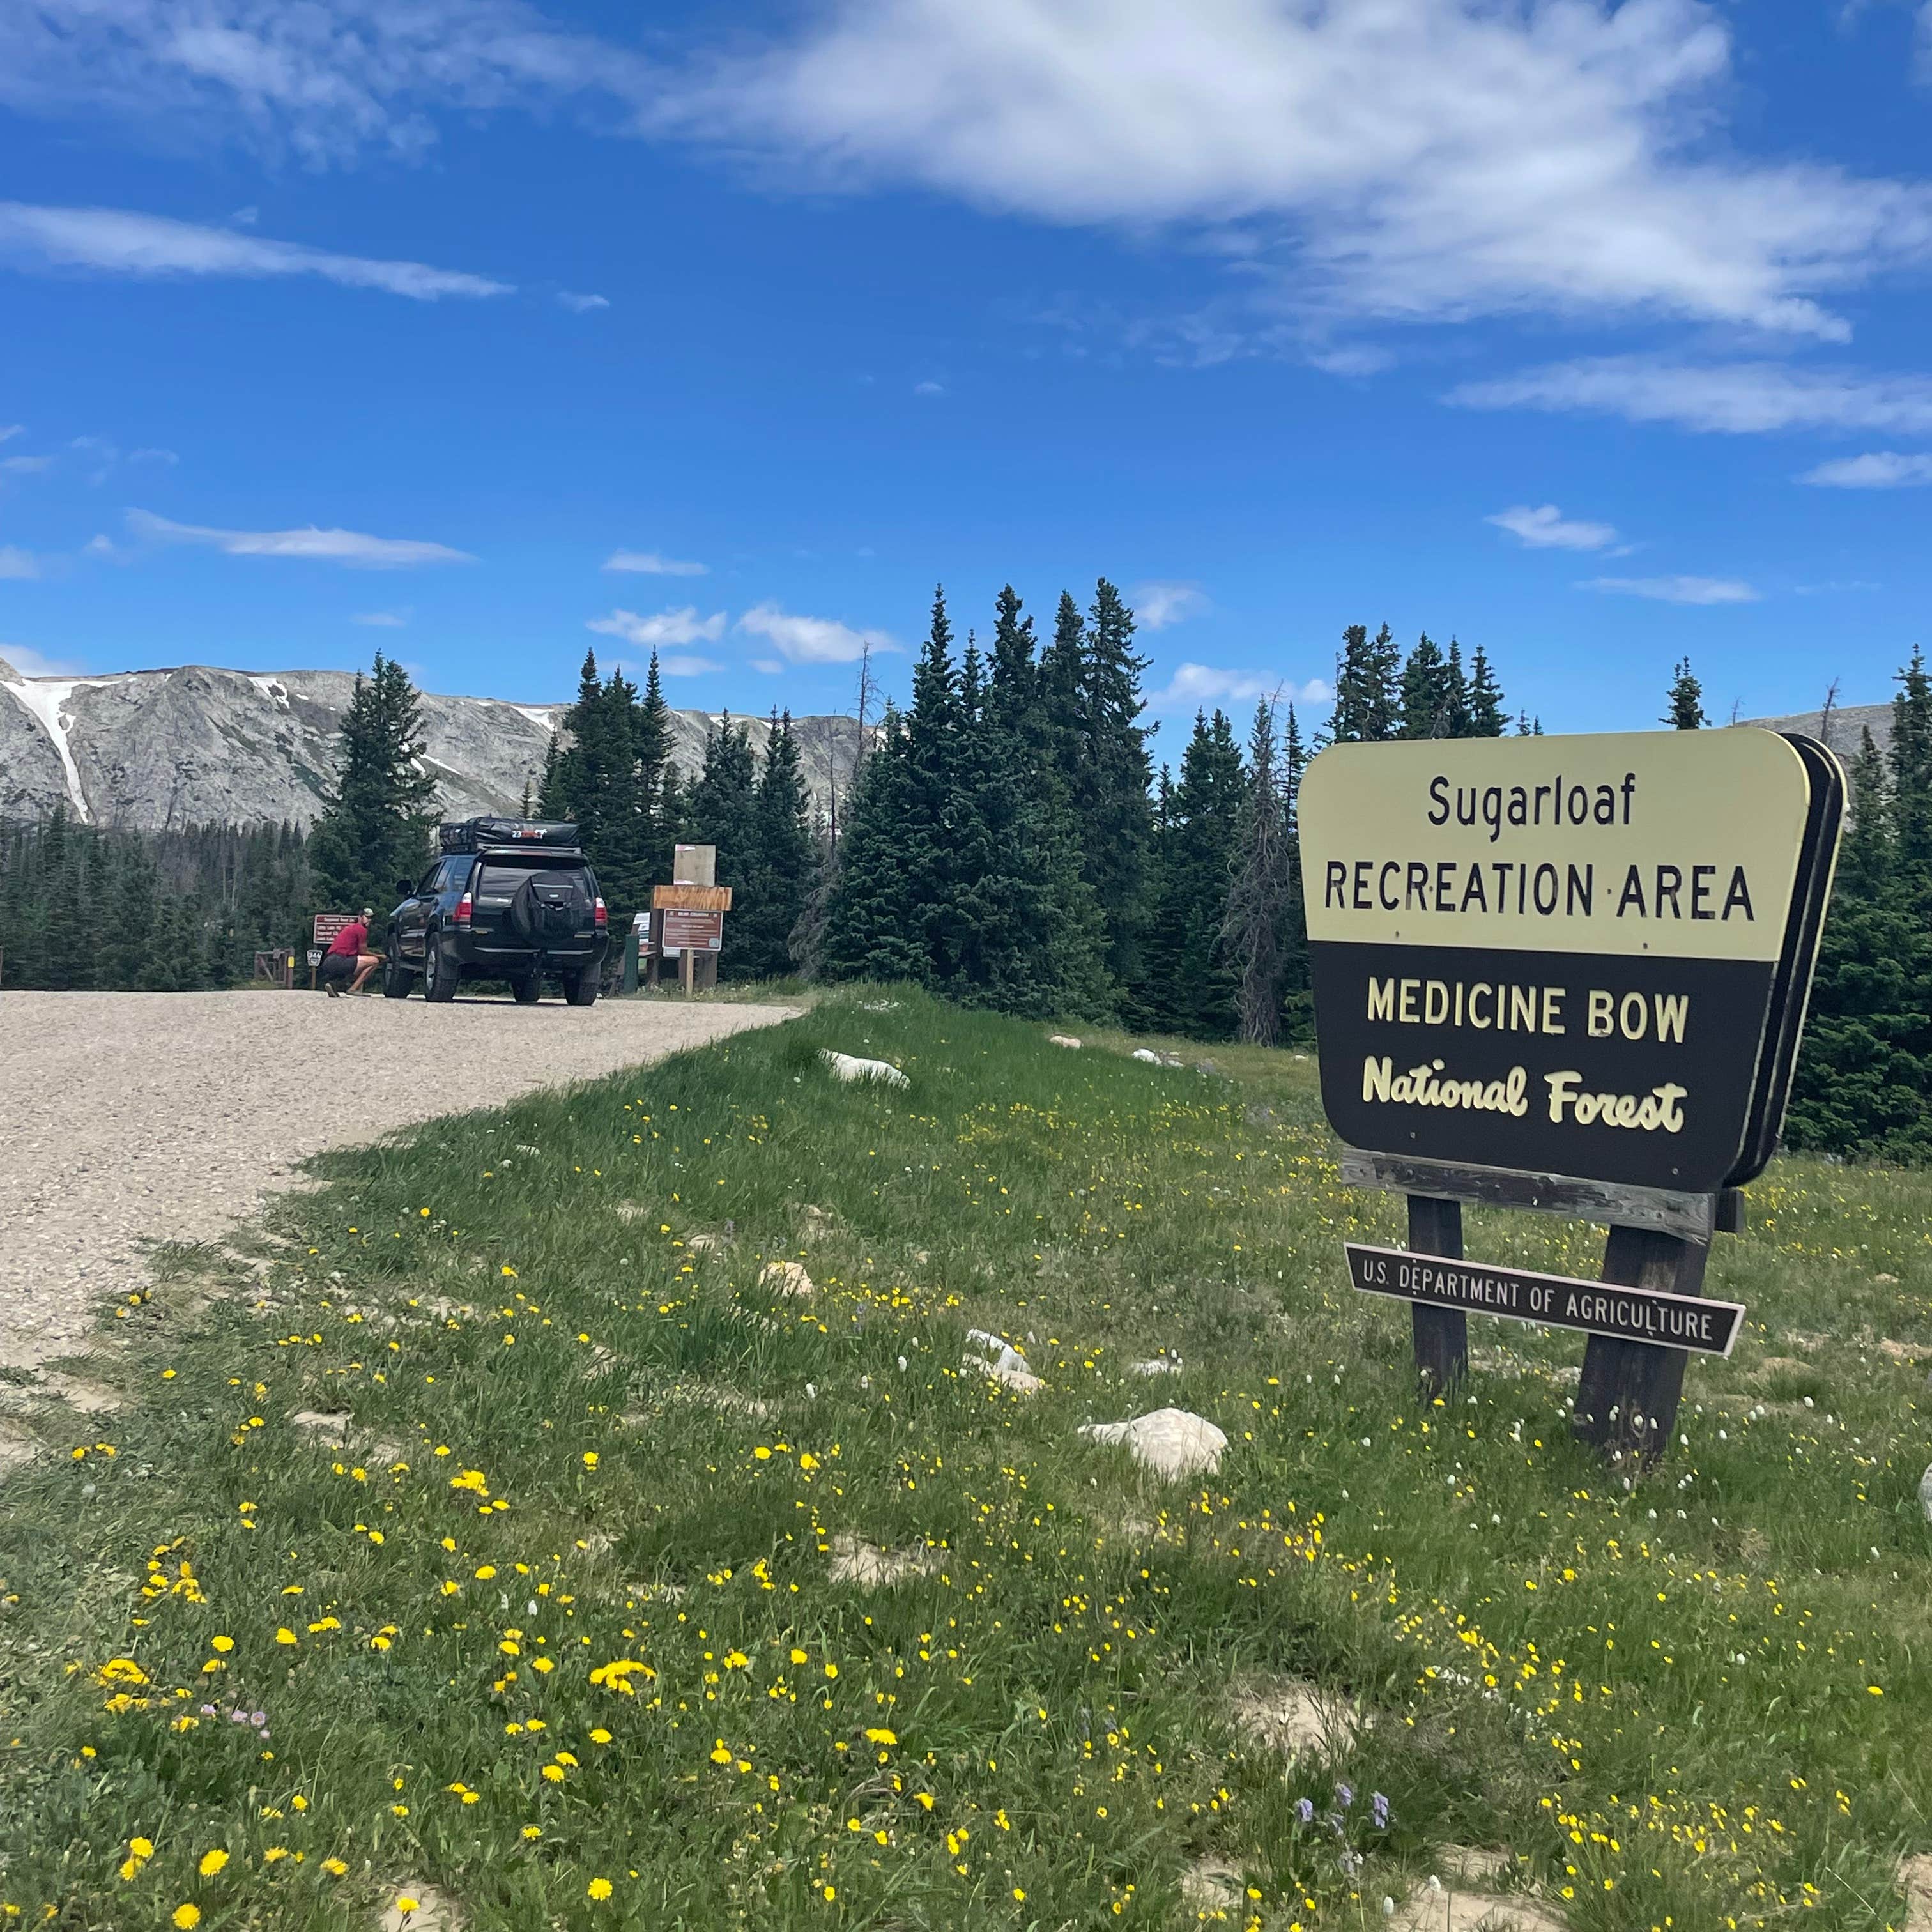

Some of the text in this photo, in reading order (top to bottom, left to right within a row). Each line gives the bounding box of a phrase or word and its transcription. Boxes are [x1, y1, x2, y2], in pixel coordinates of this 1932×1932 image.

[1427, 772, 1636, 843] Sugarloaf
[1324, 861, 1755, 922] RECREATION AREA
[1367, 976, 1689, 1043] MEDICINE BOW
[1362, 1055, 1689, 1134] National Forest
[1399, 1264, 1520, 1308] DEPARTMENT
[1529, 1286, 1555, 1313] OF
[1565, 1292, 1713, 1341] AGRICULTURE
